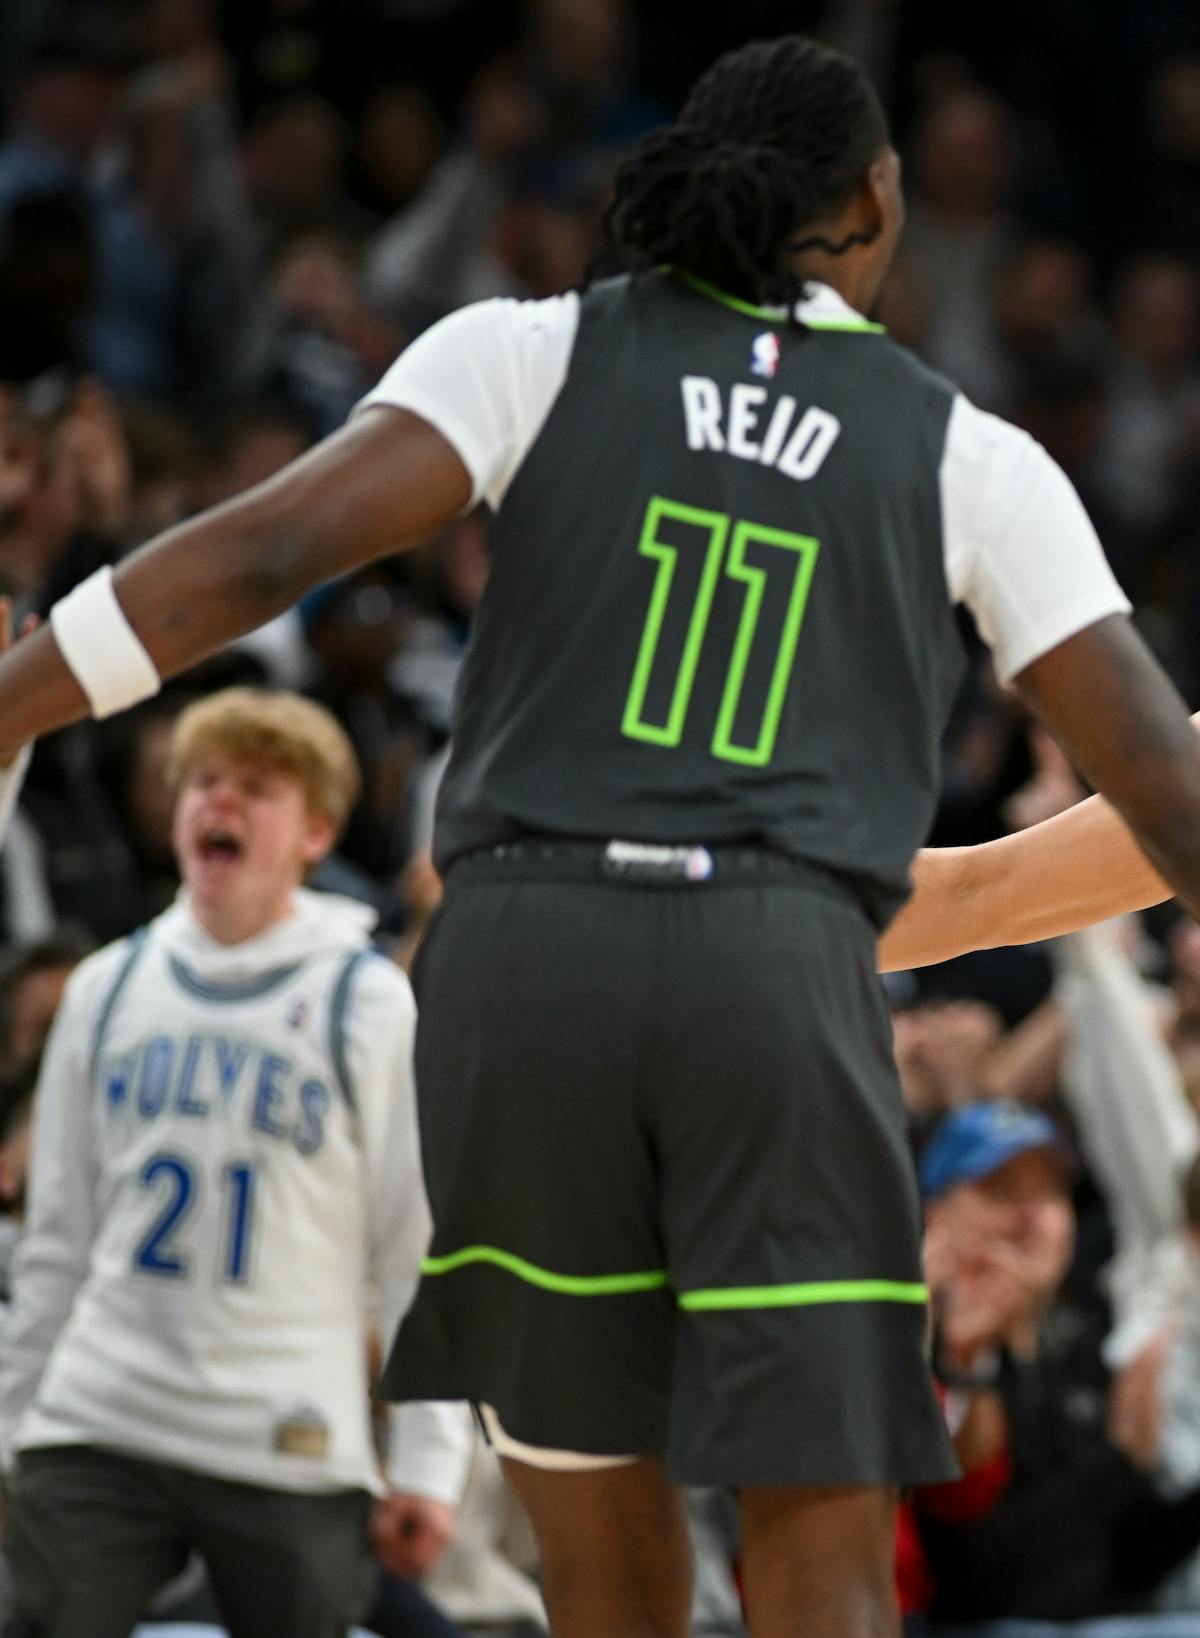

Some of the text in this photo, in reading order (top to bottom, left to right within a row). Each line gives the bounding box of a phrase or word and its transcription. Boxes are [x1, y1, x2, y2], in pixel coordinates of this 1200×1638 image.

[681, 375, 841, 481] REID
[621, 495, 820, 767] 11
[132, 1148, 258, 1285] 21
